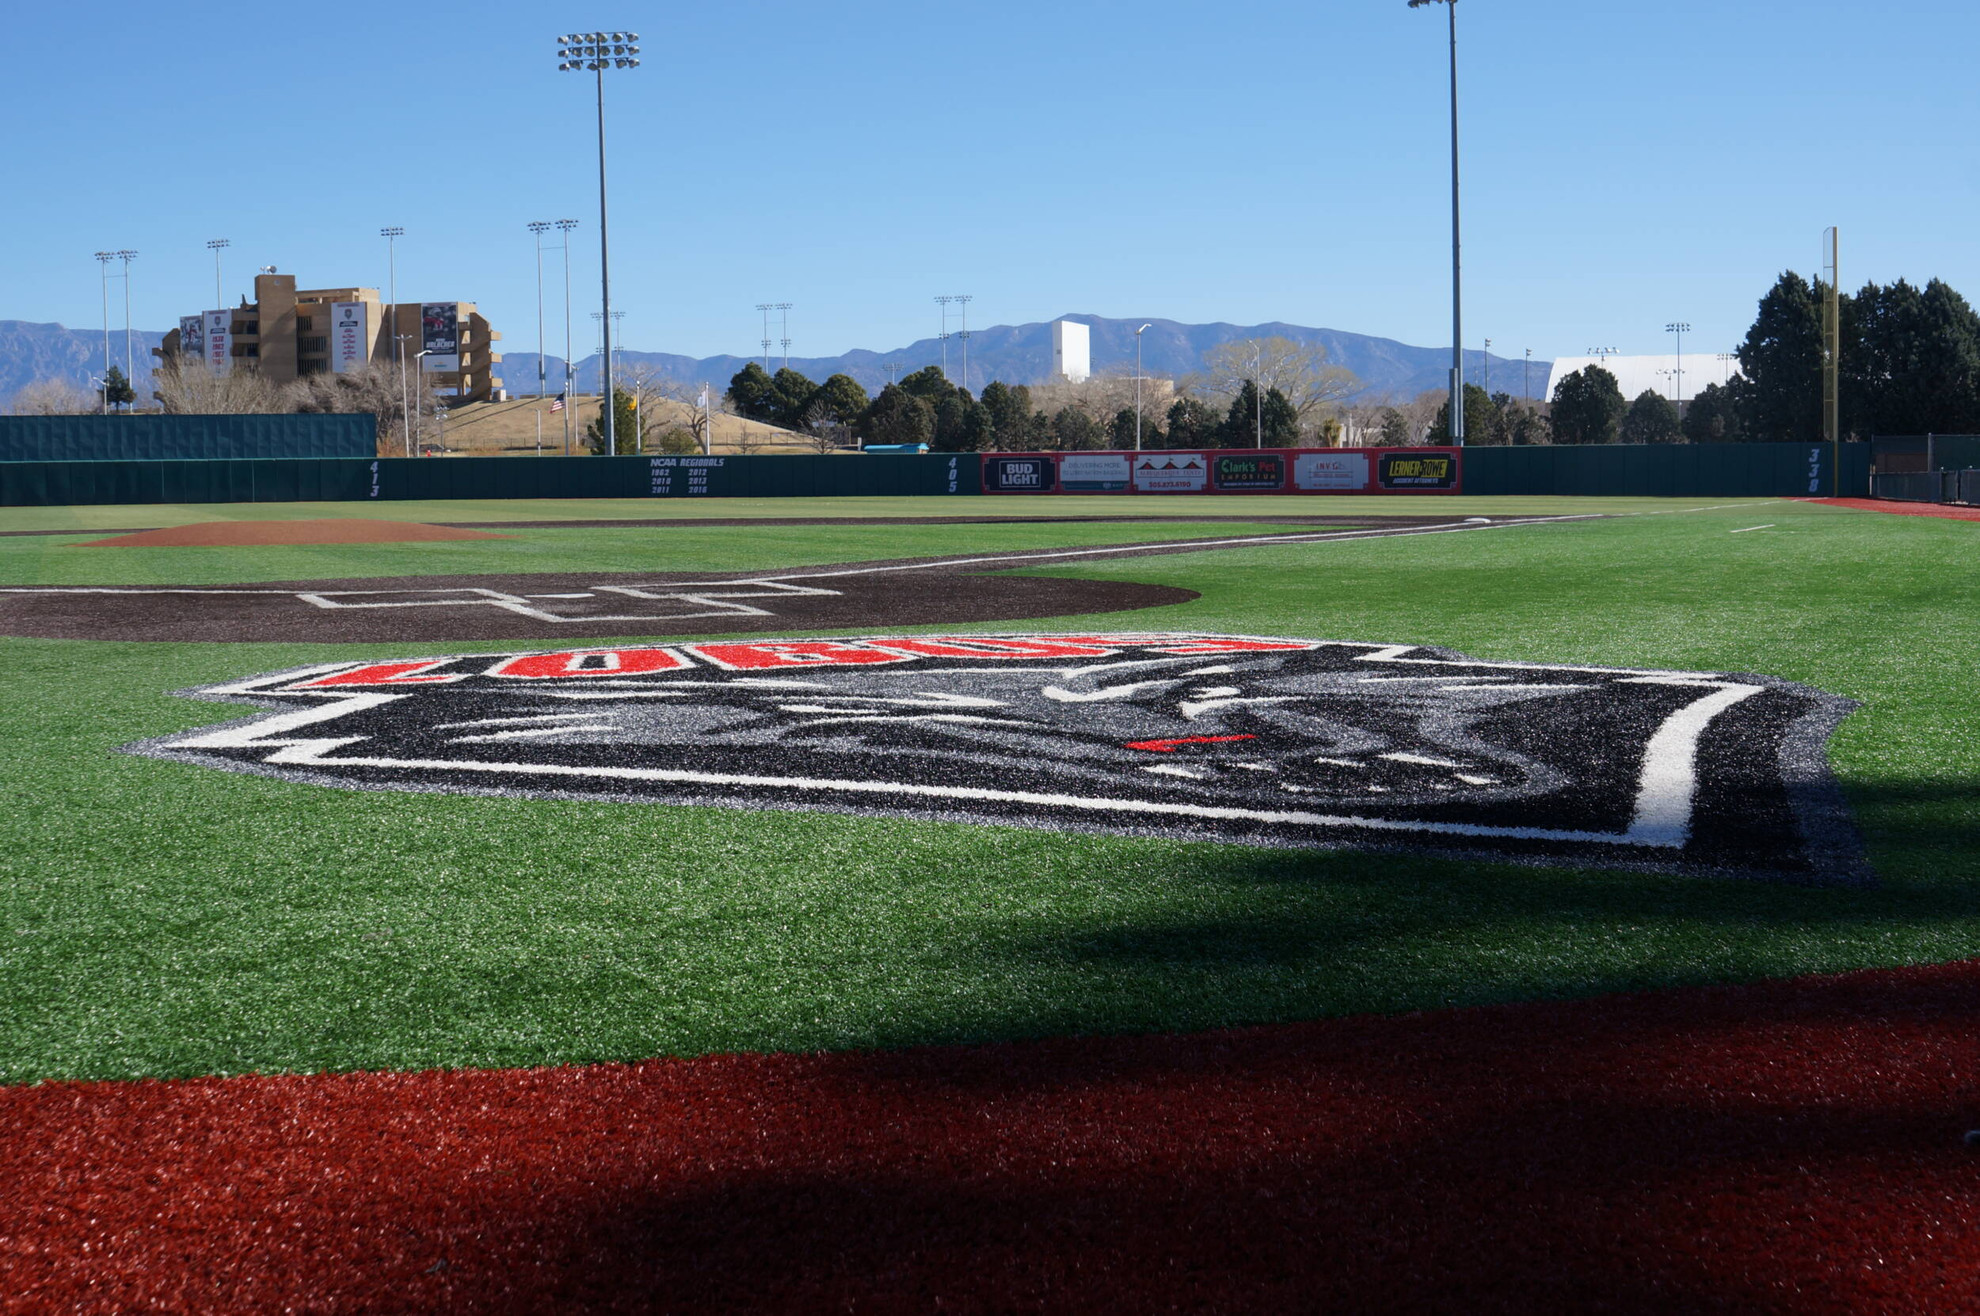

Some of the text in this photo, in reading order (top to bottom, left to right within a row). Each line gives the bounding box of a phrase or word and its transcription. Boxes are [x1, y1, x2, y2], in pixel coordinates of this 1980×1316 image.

[650, 458, 725, 467] NCAA REGIONALS
[1221, 459, 1276, 473] Clark's Pet
[688, 468, 708, 476] 2012
[1006, 463, 1033, 474] BUD
[651, 477, 672, 485] 2010
[688, 477, 708, 485] 2013
[1002, 474, 1038, 485] LIGHT
[651, 486, 670, 494] 2011
